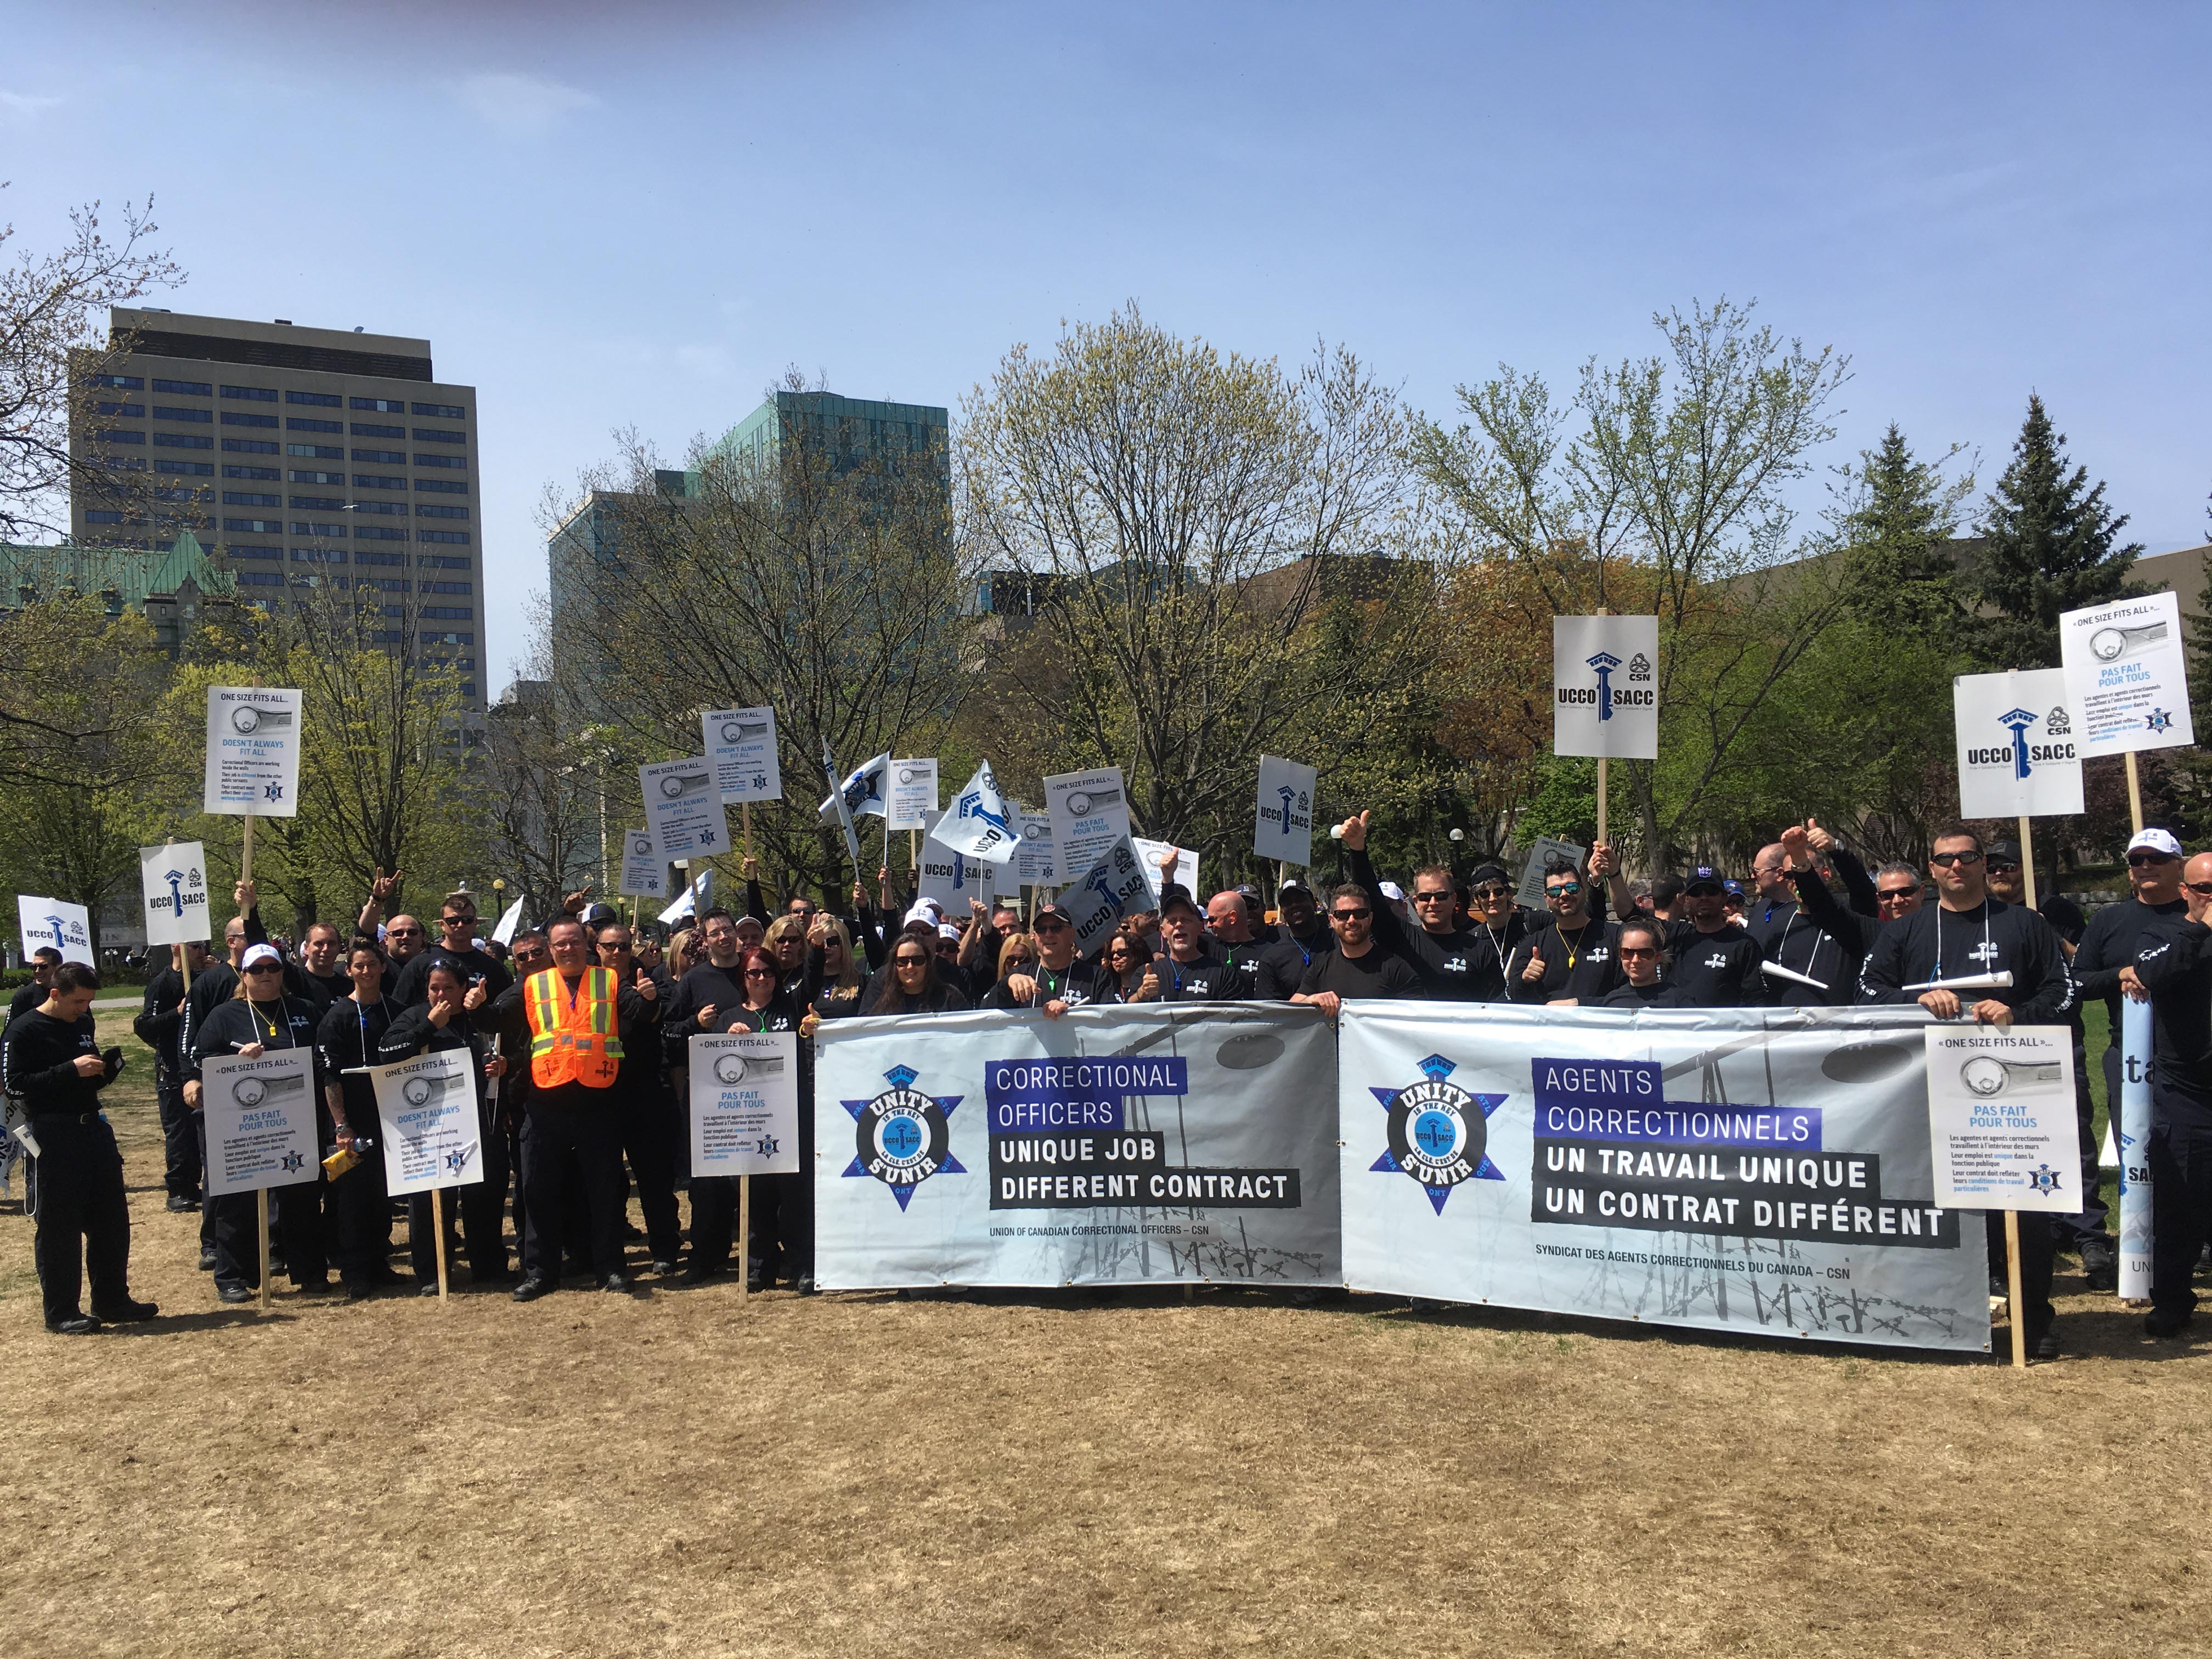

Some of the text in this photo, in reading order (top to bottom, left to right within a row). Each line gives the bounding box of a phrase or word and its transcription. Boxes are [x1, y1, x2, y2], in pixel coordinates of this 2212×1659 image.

[2078, 606, 2148, 627] ONE SIZE FITS ALL
[2102, 663, 2142, 677] PAS FAIT
[2099, 672, 2151, 687] POUR TOUS
[1559, 689, 1653, 705] UCCO SACC
[2047, 727, 2071, 735] CSN
[1968, 743, 2075, 764] UCCO SACC
[1261, 806, 1308, 828] UCCO SACC
[973, 829, 1001, 852] UCCO
[926, 864, 953, 877] UCCO
[1119, 860, 1136, 874] CSN
[150, 893, 205, 909] UCCO SACC
[1076, 906, 1111, 939] UCCO
[27, 930, 87, 946] UCCO SACC
[1945, 1039, 1966, 1048] ONE
[1968, 1039, 1991, 1047] SIZE
[1994, 1038, 2016, 1047] FITS
[2019, 1038, 2039, 1046] ALL
[996, 1064, 1177, 1091] CORRECTIONAL
[1546, 1066, 1652, 1094] AGENTS
[718, 1099, 765, 1109] POUR TOUS
[740, 1091, 759, 1099] FAIT
[869, 1091, 933, 1115] UNITY
[1400, 1082, 1471, 1109] UNITY
[882, 1114, 890, 1122] IS
[907, 1111, 922, 1121] KEY
[999, 1101, 1113, 1126] OFFICERS
[1413, 1108, 1421, 1116] IS
[1441, 1105, 1457, 1116] KEY
[1974, 1106, 2027, 1116] PAS FAIT
[1548, 1105, 1809, 1142] CORRECTIONNELS
[1970, 1118, 2037, 1127] POUR TOUS
[882, 1150, 888, 1159] LA
[917, 1150, 925, 1159] DE
[1001, 1138, 1156, 1166] UNIQUE JOB
[1414, 1147, 1421, 1156] LA
[1451, 1150, 1459, 1159] DE
[868, 1156, 938, 1183] S'UNIR
[1401, 1154, 1472, 1184] S'UNIR
[1547, 1146, 1866, 1188] UN TRAVAIL UNIQUE
[1002, 1174, 1287, 1199] DIFFERENT CONTRACT
[1546, 1187, 1944, 1237] UN CONTRAT DIFFÉRENT
[990, 1224, 1209, 1237] UNION OF CANADIAN CORRECTIONAL OFFICERS CSN
[1536, 1244, 1850, 1279] SYNDICAT DES AGENTS CORRECTIONNELS DU CANADA CSN
